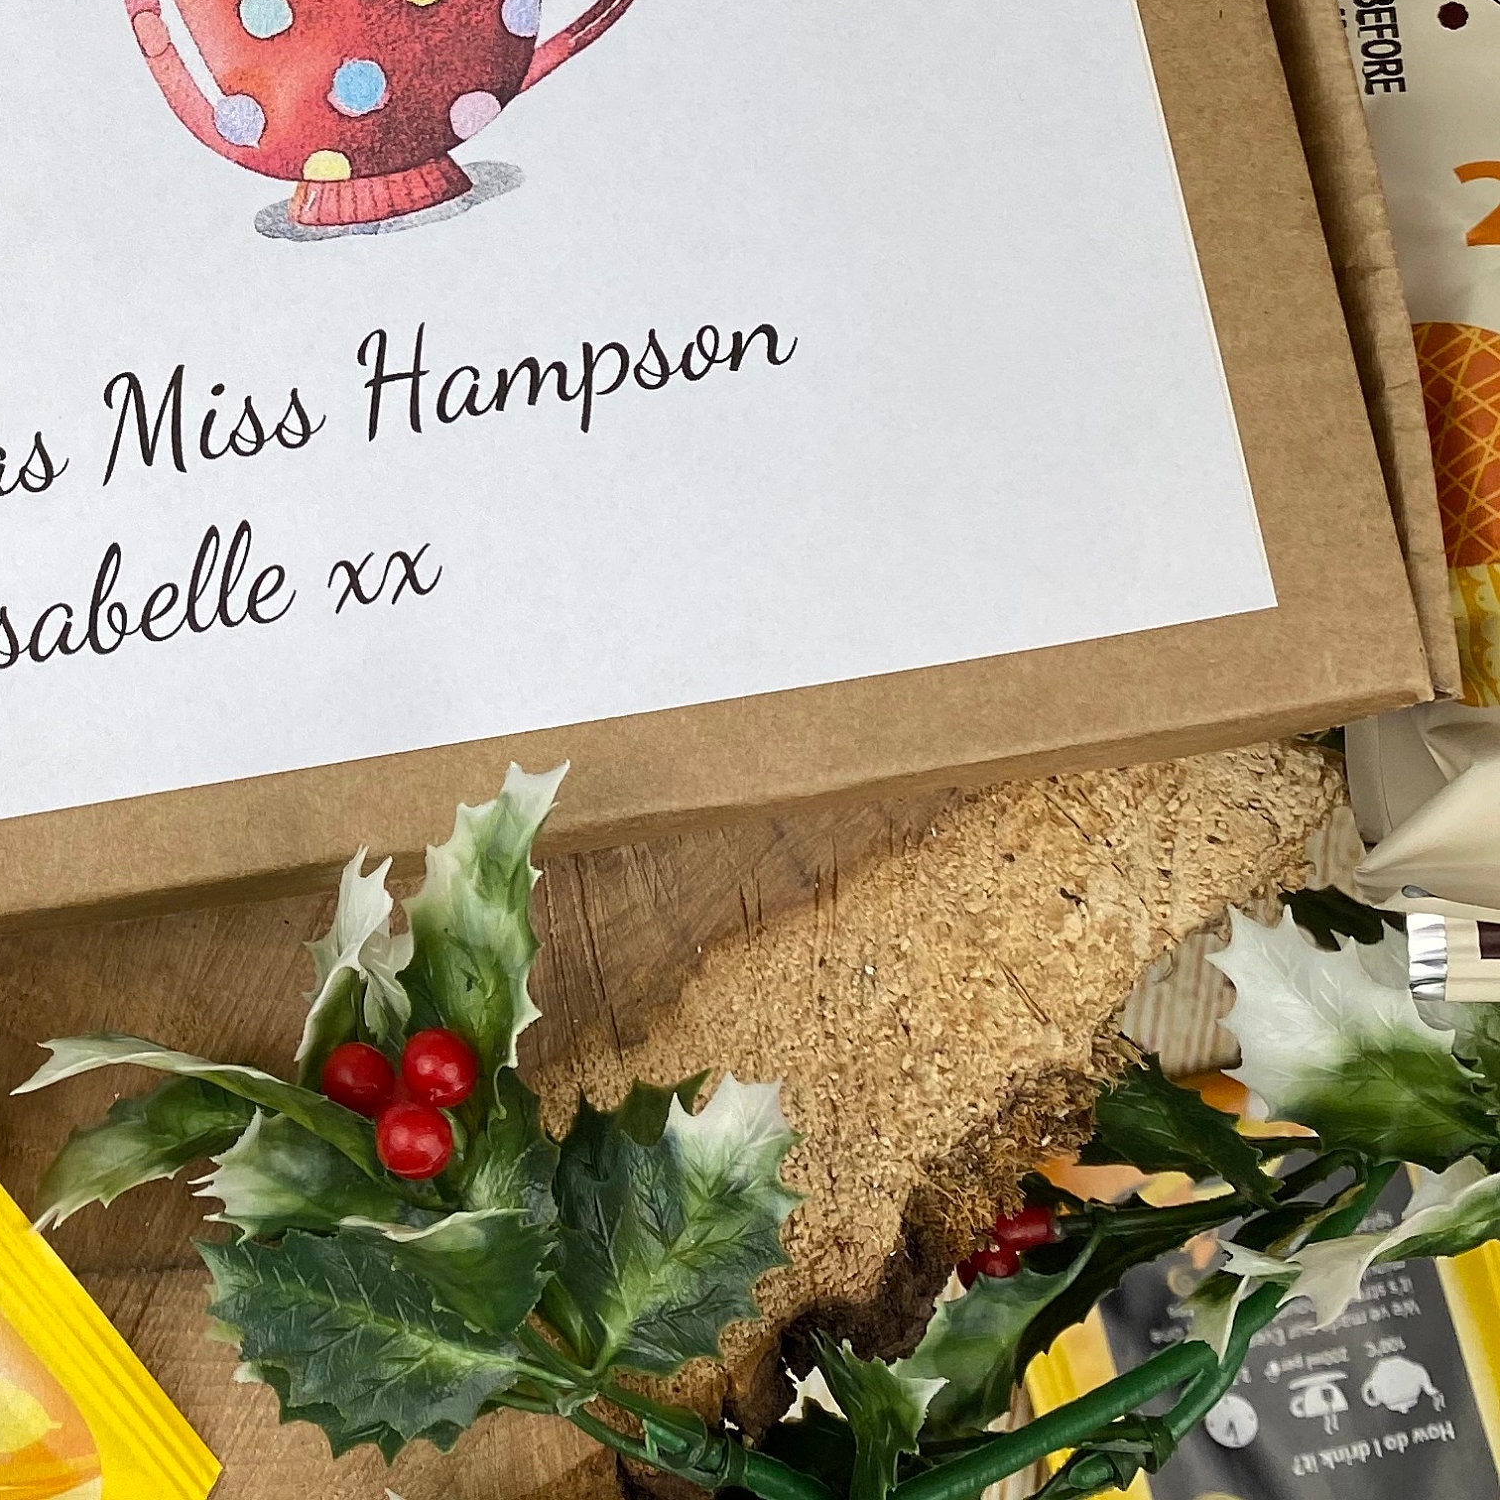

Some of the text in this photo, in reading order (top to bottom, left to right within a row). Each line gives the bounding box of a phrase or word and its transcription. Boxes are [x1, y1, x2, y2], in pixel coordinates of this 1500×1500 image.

[102, 364, 327, 486] Miss
[357, 322, 799, 441] Hampson
[327, 542, 442, 613] xx
[1292, 1420, 1456, 1477] How do I drink it?
